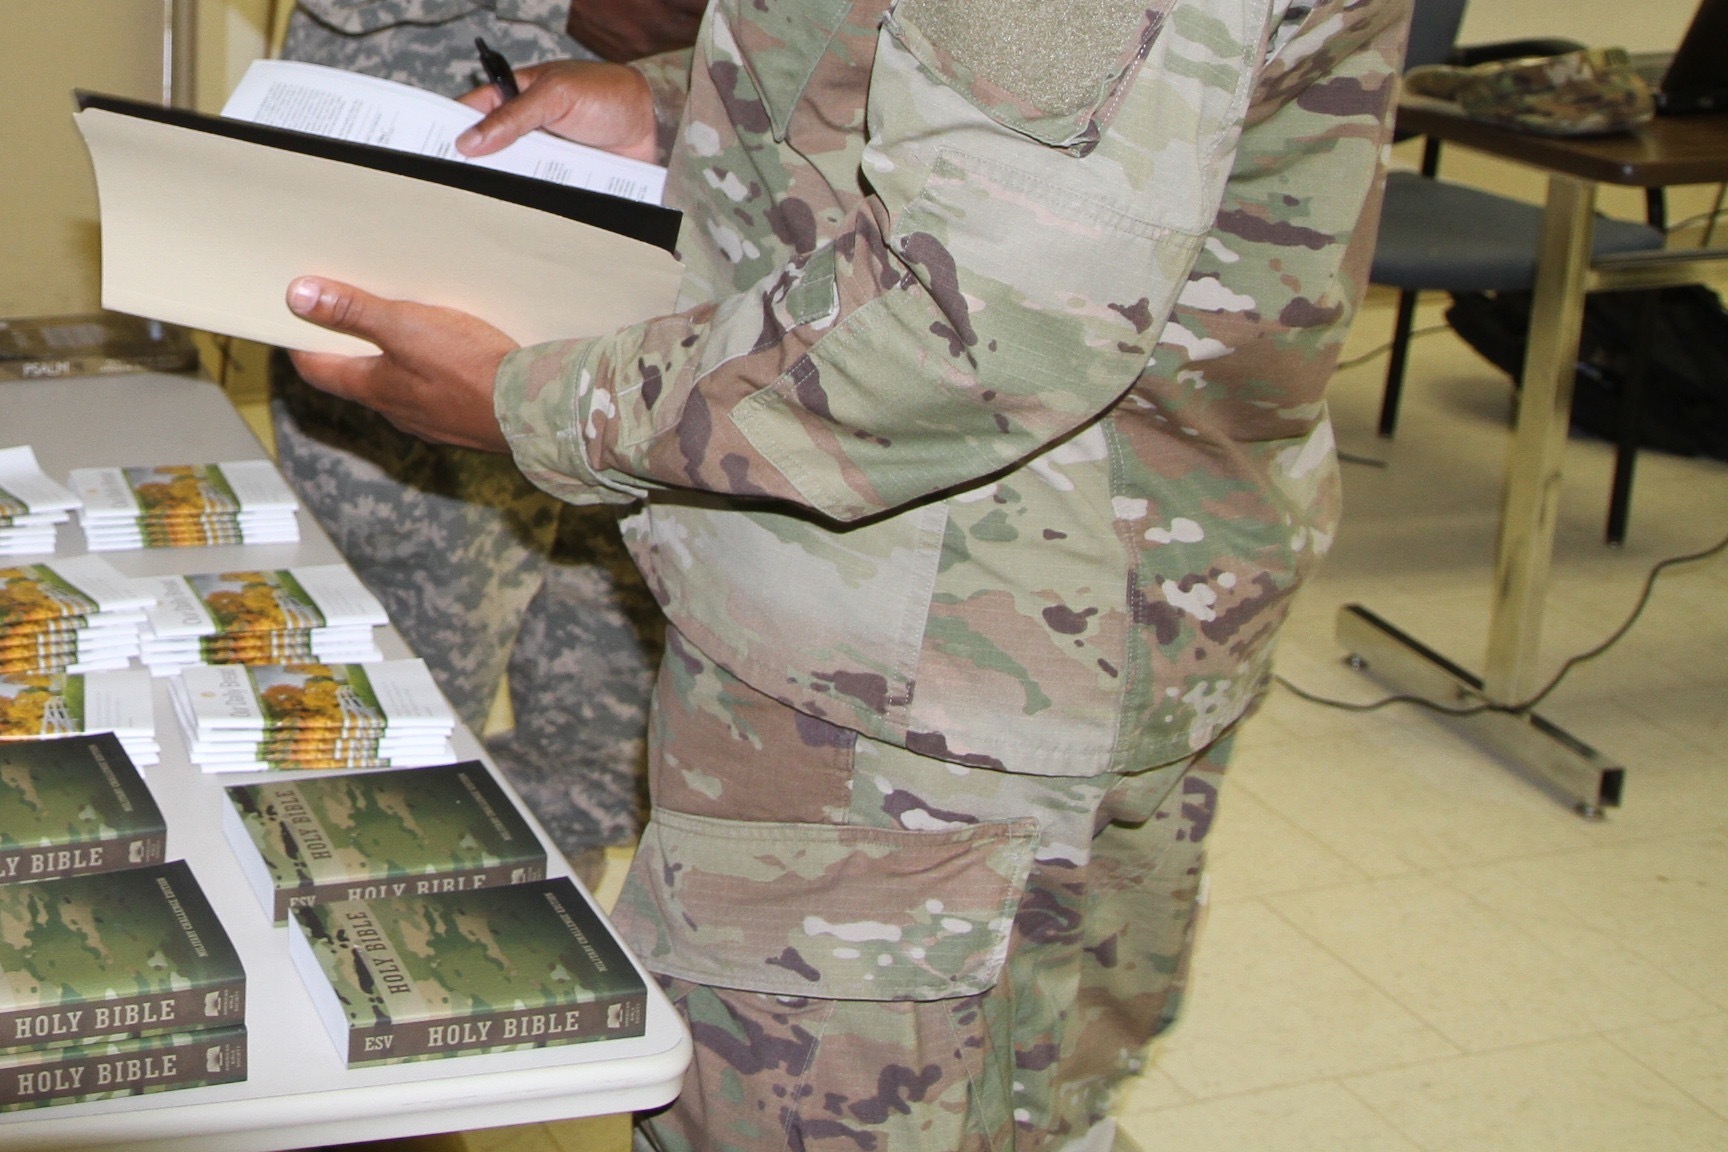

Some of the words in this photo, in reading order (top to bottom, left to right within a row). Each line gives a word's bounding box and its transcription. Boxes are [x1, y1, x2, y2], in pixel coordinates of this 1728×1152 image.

[23, 361, 71, 377] PSALM
[275, 790, 312, 824] BIBLE
[30, 847, 103, 874] BIBLE
[299, 829, 332, 860] HOLY
[346, 912, 387, 952] BIBLE
[373, 958, 411, 995] HOLY
[15, 1010, 84, 1040] HOLY
[95, 999, 176, 1029] BIBLE
[427, 1021, 492, 1047] HOLY
[503, 1010, 580, 1039] BIBLE
[364, 1035, 394, 1052] ESV
[17, 1066, 85, 1096] HOLY
[97, 1054, 177, 1085] BIBLE
